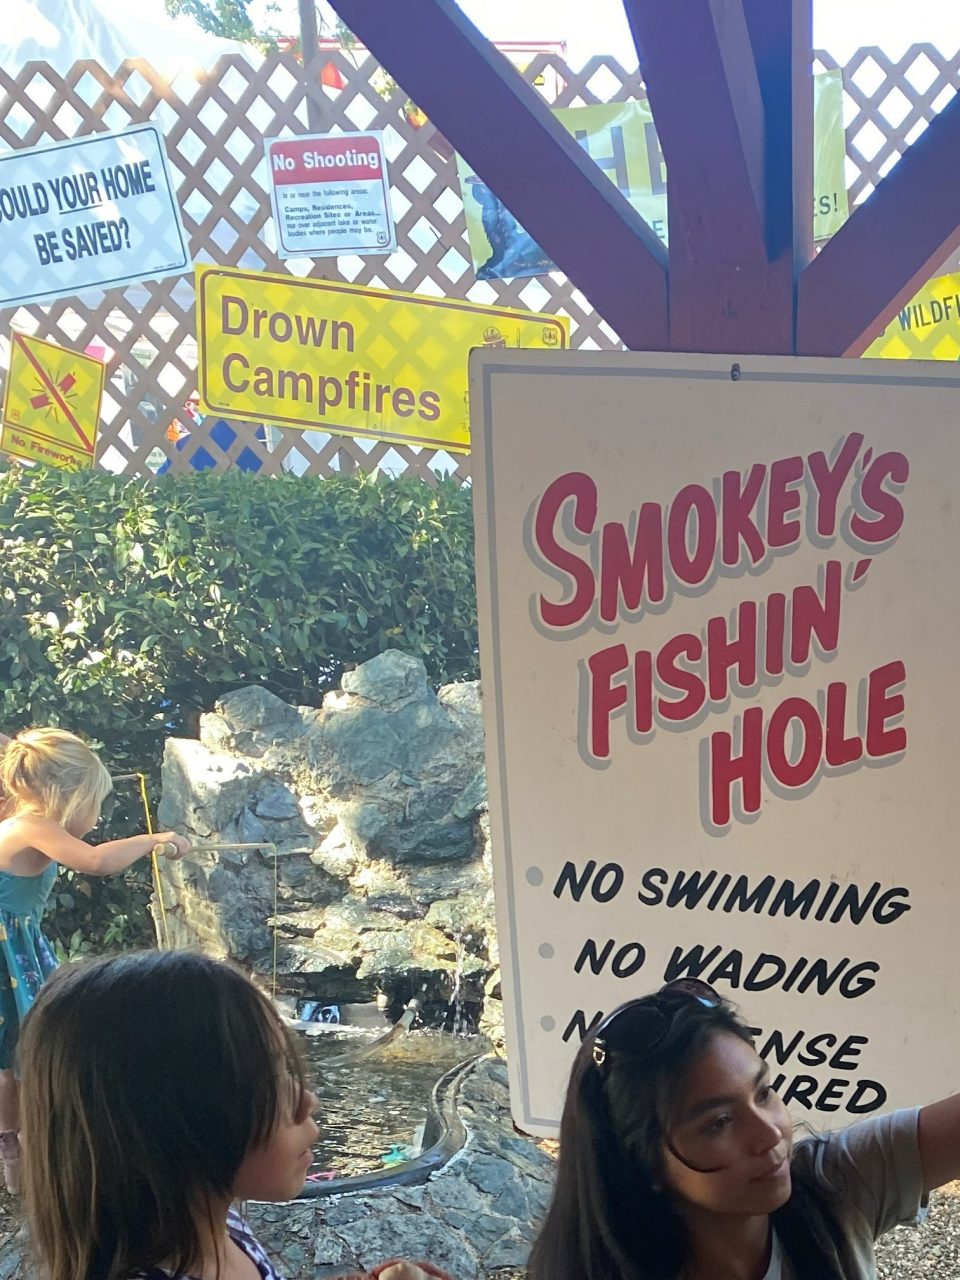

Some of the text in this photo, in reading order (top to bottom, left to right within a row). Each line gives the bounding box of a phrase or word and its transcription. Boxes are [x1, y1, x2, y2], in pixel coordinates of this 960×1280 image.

[0, 160, 155, 222] OULD YOUR HOME
[272, 149, 379, 171] No Shooting
[33, 217, 131, 266] BE SAVED?
[221, 294, 355, 353] Drown
[222, 352, 442, 422] Campfires
[11, 433, 83, 468] No Fireworks
[531, 431, 910, 632] SMOKEY'S
[585, 557, 873, 762] FISHIN'
[706, 659, 908, 830] HOLE
[553, 860, 912, 926] NO SWIMMING
[574, 938, 881, 999] NO WADING
